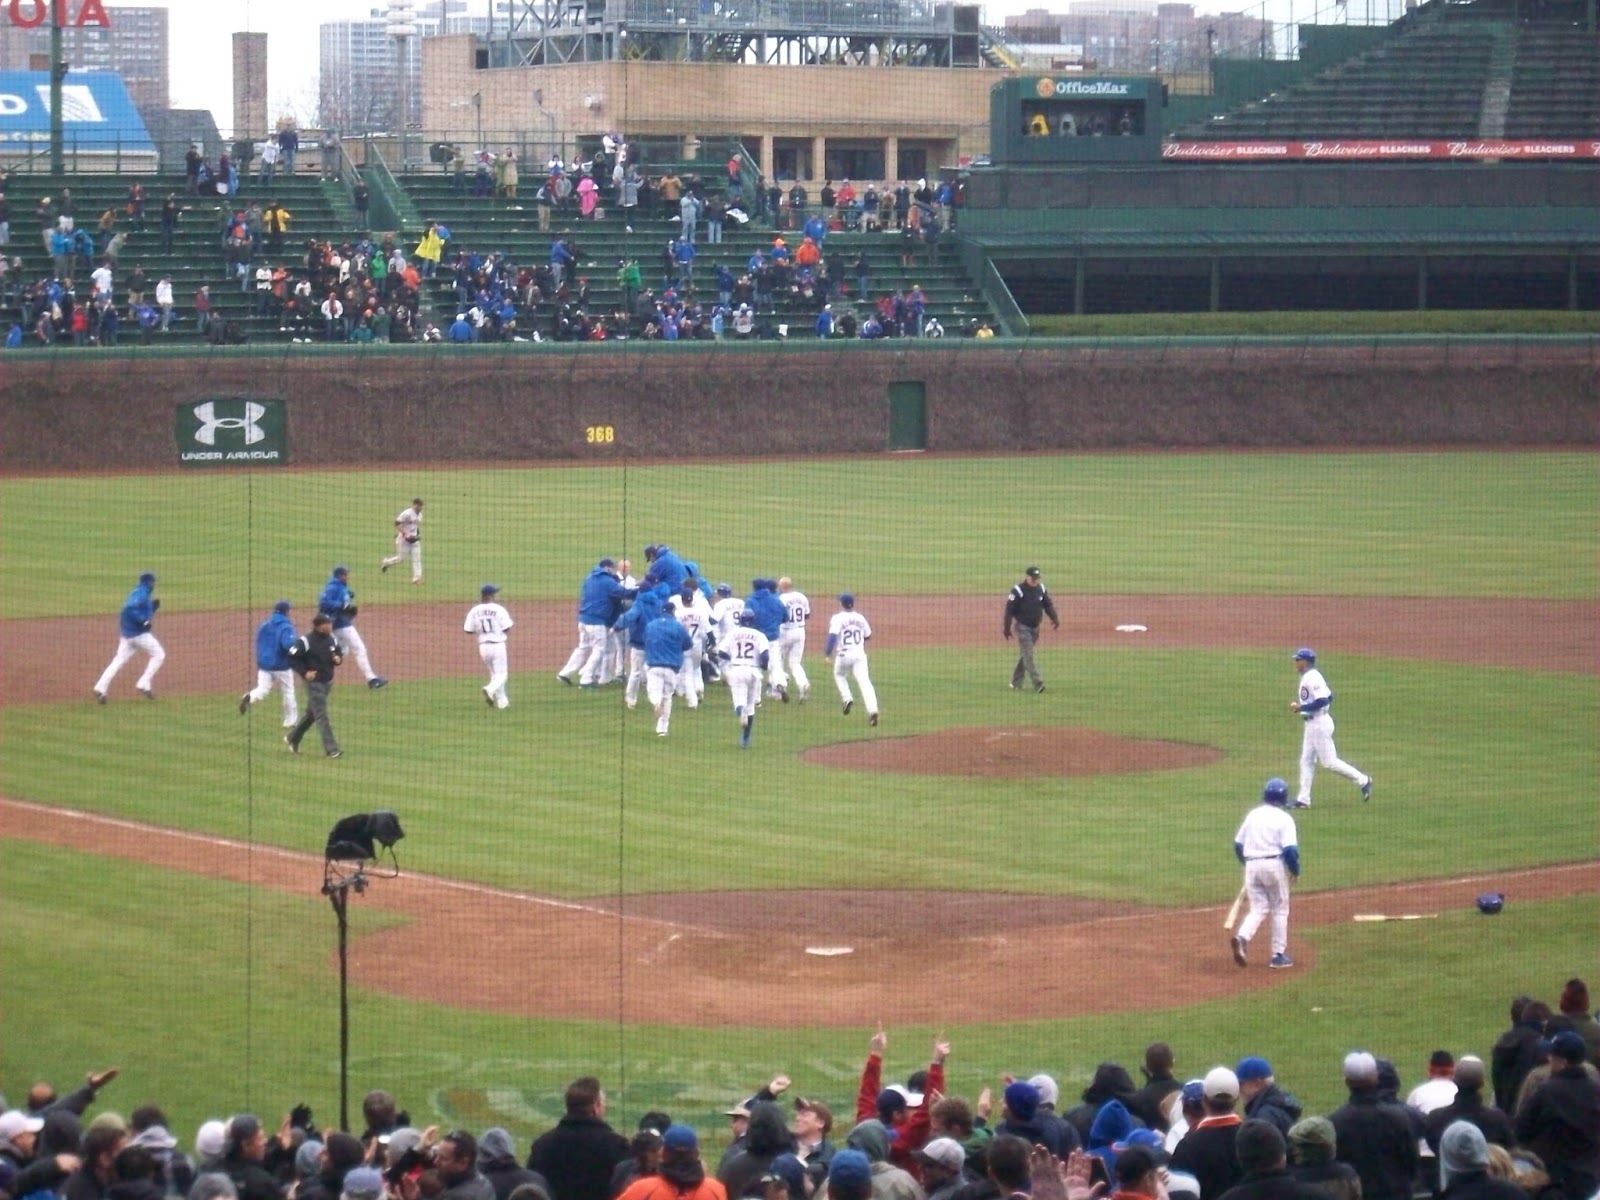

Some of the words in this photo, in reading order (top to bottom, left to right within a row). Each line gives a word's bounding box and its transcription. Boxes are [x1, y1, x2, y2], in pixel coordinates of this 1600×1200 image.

[1056, 81, 1129, 95] OfficeMax
[1162, 143, 1234, 157] Budweiser
[1236, 145, 1288, 155] BLEACHERS
[1302, 142, 1377, 156] Budweiser
[1379, 145, 1431, 154] BLEACHERS
[1447, 142, 1522, 156] Budweiser
[1524, 145, 1576, 154] BLEACHERS
[586, 426, 614, 443] 368
[181, 452, 223, 461] UNDER
[226, 451, 279, 460] ARMOUR
[789, 607, 803, 623] 19
[480, 618, 495, 634] 11
[843, 629, 862, 646] 20
[736, 642, 755, 659] 12
